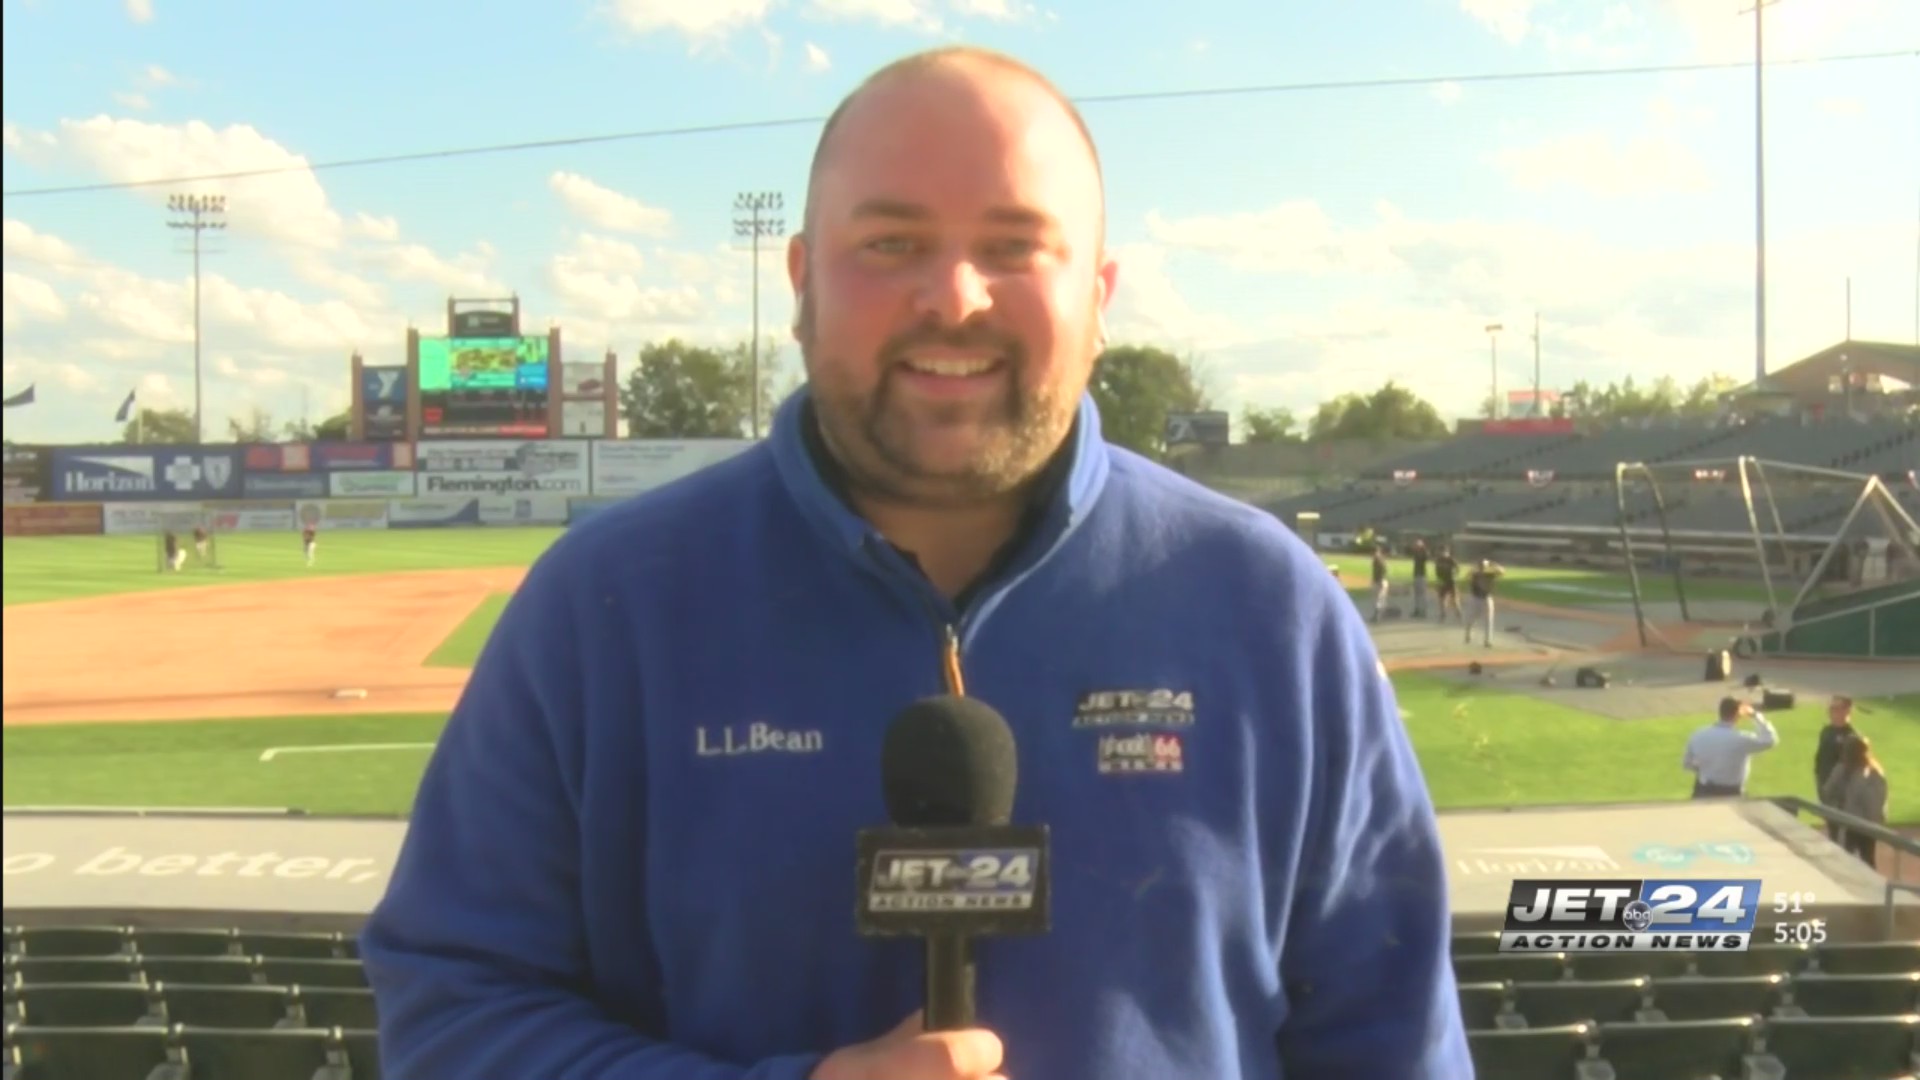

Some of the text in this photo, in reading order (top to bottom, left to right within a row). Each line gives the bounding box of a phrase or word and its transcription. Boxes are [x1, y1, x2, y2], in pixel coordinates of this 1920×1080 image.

[65, 471, 156, 492] Horizon
[427, 475, 581, 496] Flemington.com
[1146, 689, 1193, 711] 24
[876, 856, 1031, 888] JET 24
